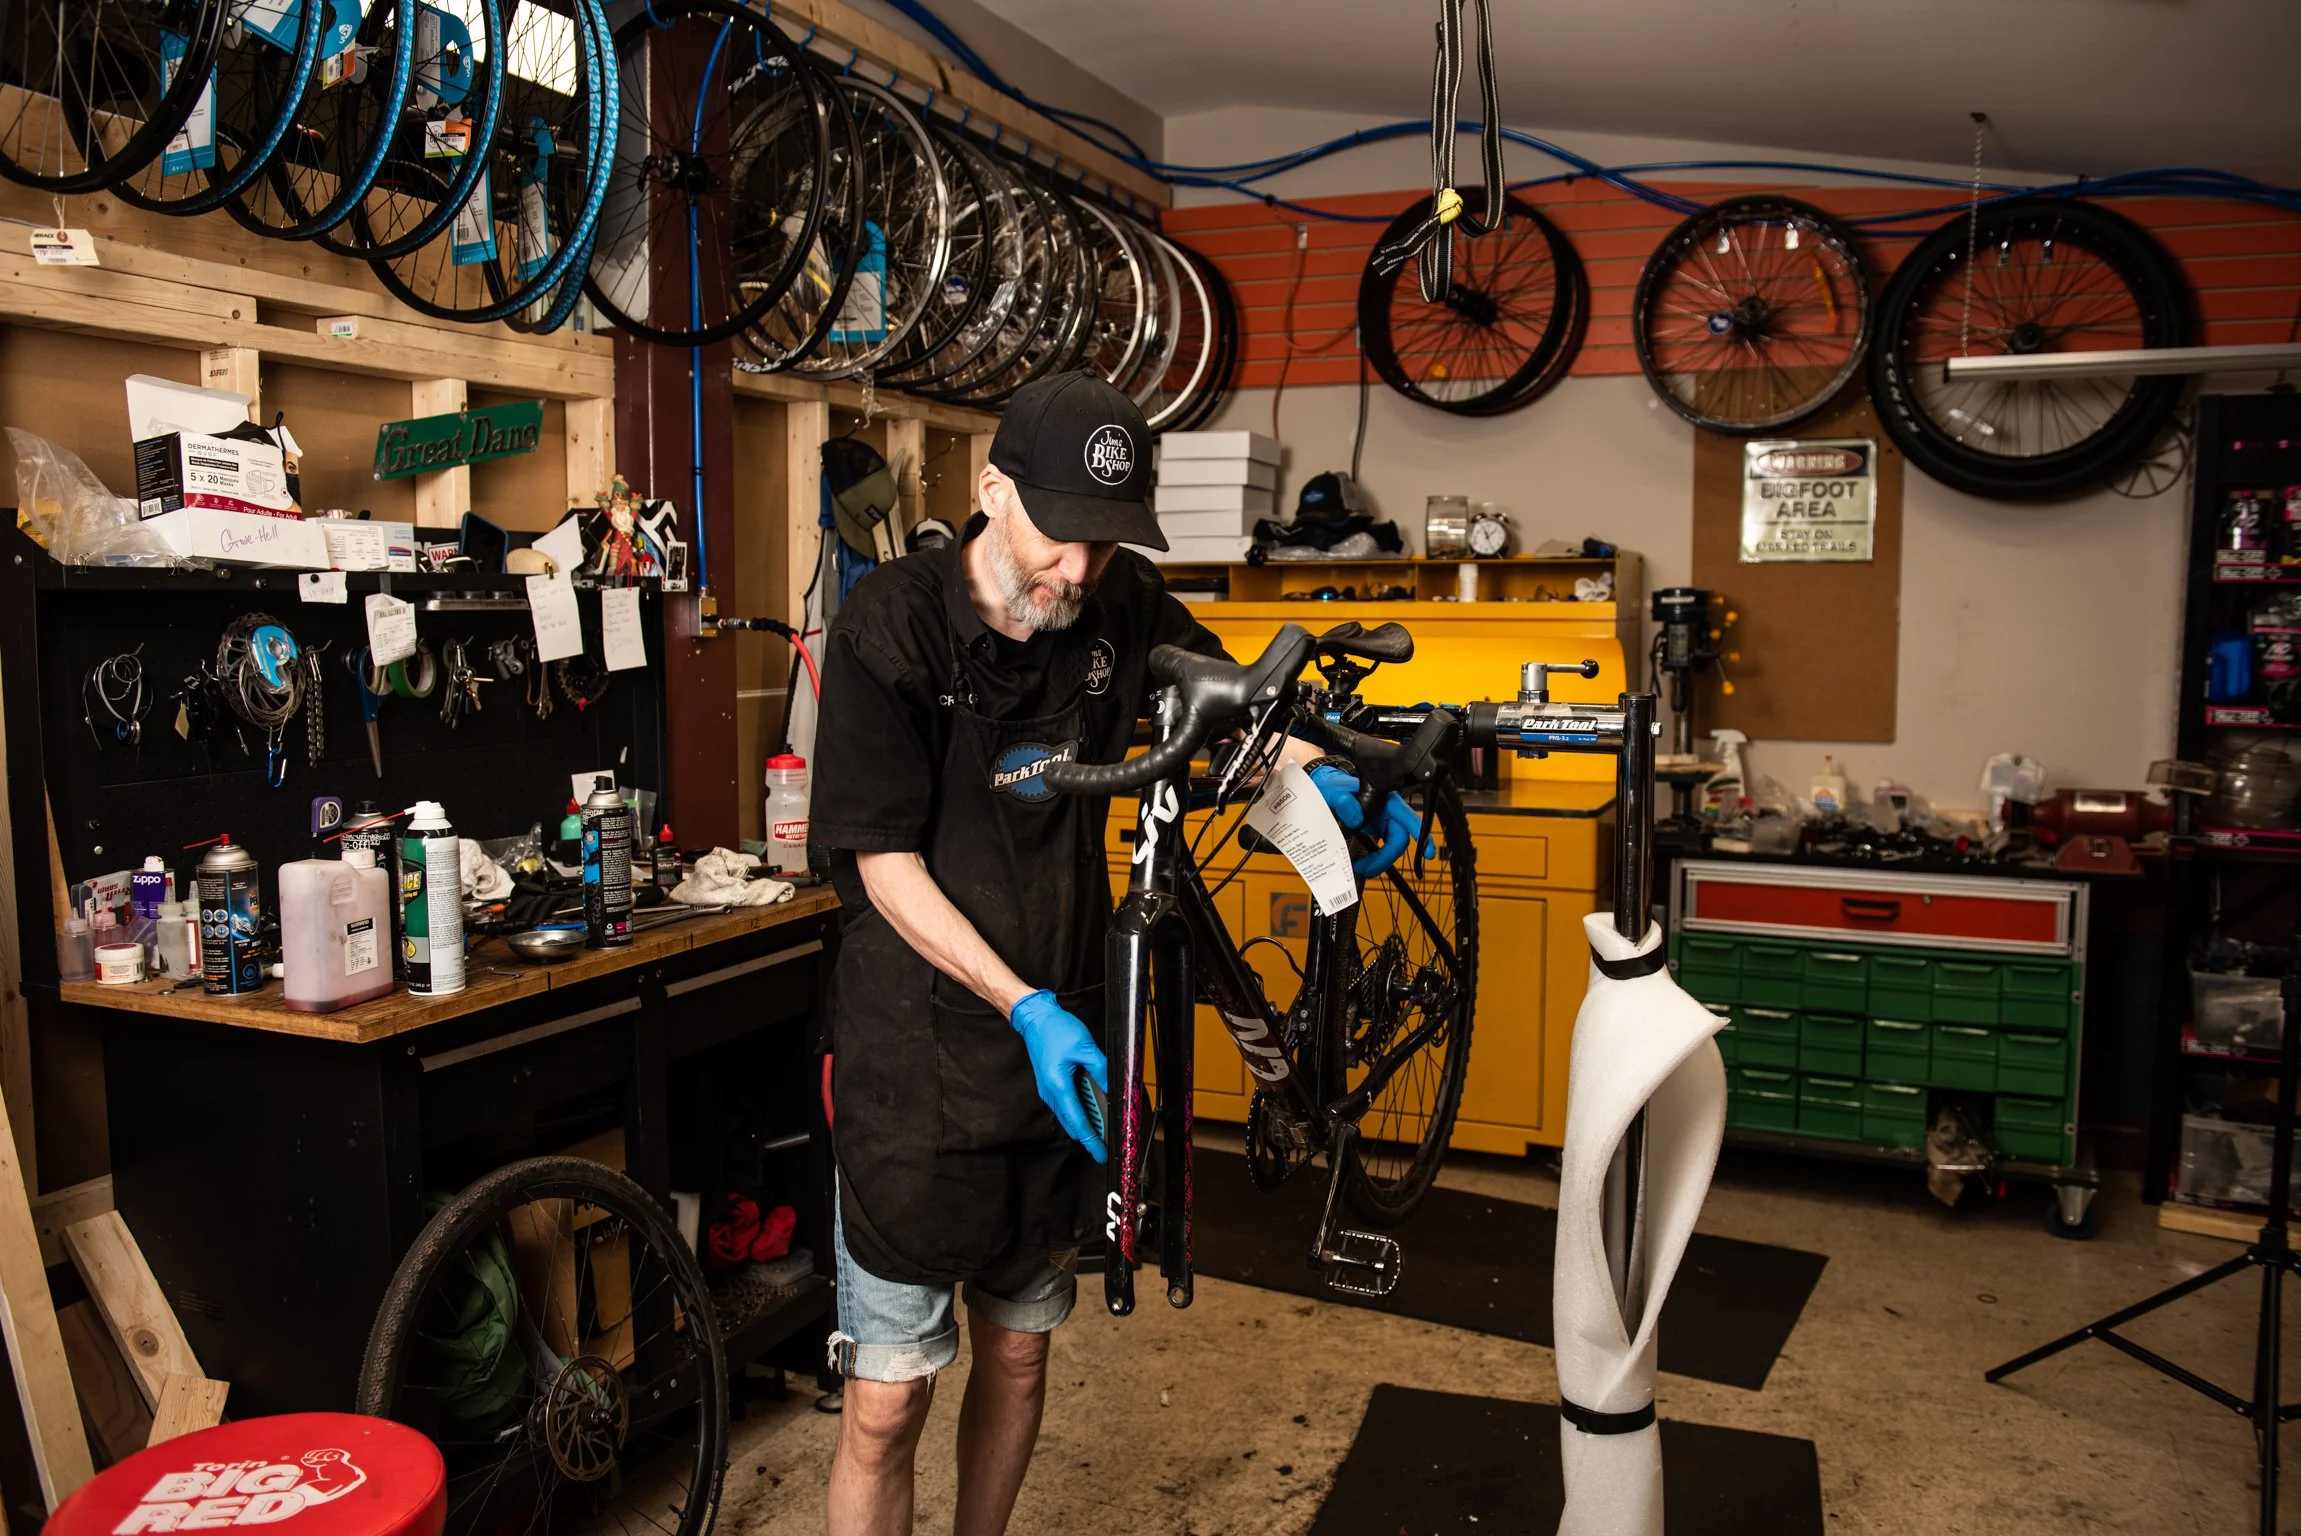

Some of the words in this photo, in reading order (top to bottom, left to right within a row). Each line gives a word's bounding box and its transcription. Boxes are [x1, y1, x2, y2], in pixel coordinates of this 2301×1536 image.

[188, 443, 239, 456] DERMATHERMES
[382, 426, 464, 474] Great
[468, 416, 538, 458] Dane
[1091, 443, 1127, 468] BIKE
[1770, 454, 1847, 470] WARNING
[1101, 459, 1131, 477] SHOP
[190, 472, 197, 481] 5
[207, 474, 219, 485] 20
[1760, 481, 1859, 498] BIGFOOT
[243, 506, 257, 515] Pour
[1776, 501, 1837, 518] AREA
[1780, 529, 1812, 540] STAY
[1814, 529, 1833, 540] ON
[1756, 541, 1809, 553] MARKED
[1812, 541, 1857, 553] TRAILS
[1090, 667, 1111, 688] SHOP
[192, 1459, 268, 1473] Torin
[141, 1463, 304, 1503] BIG
[112, 1491, 307, 1536] RED
